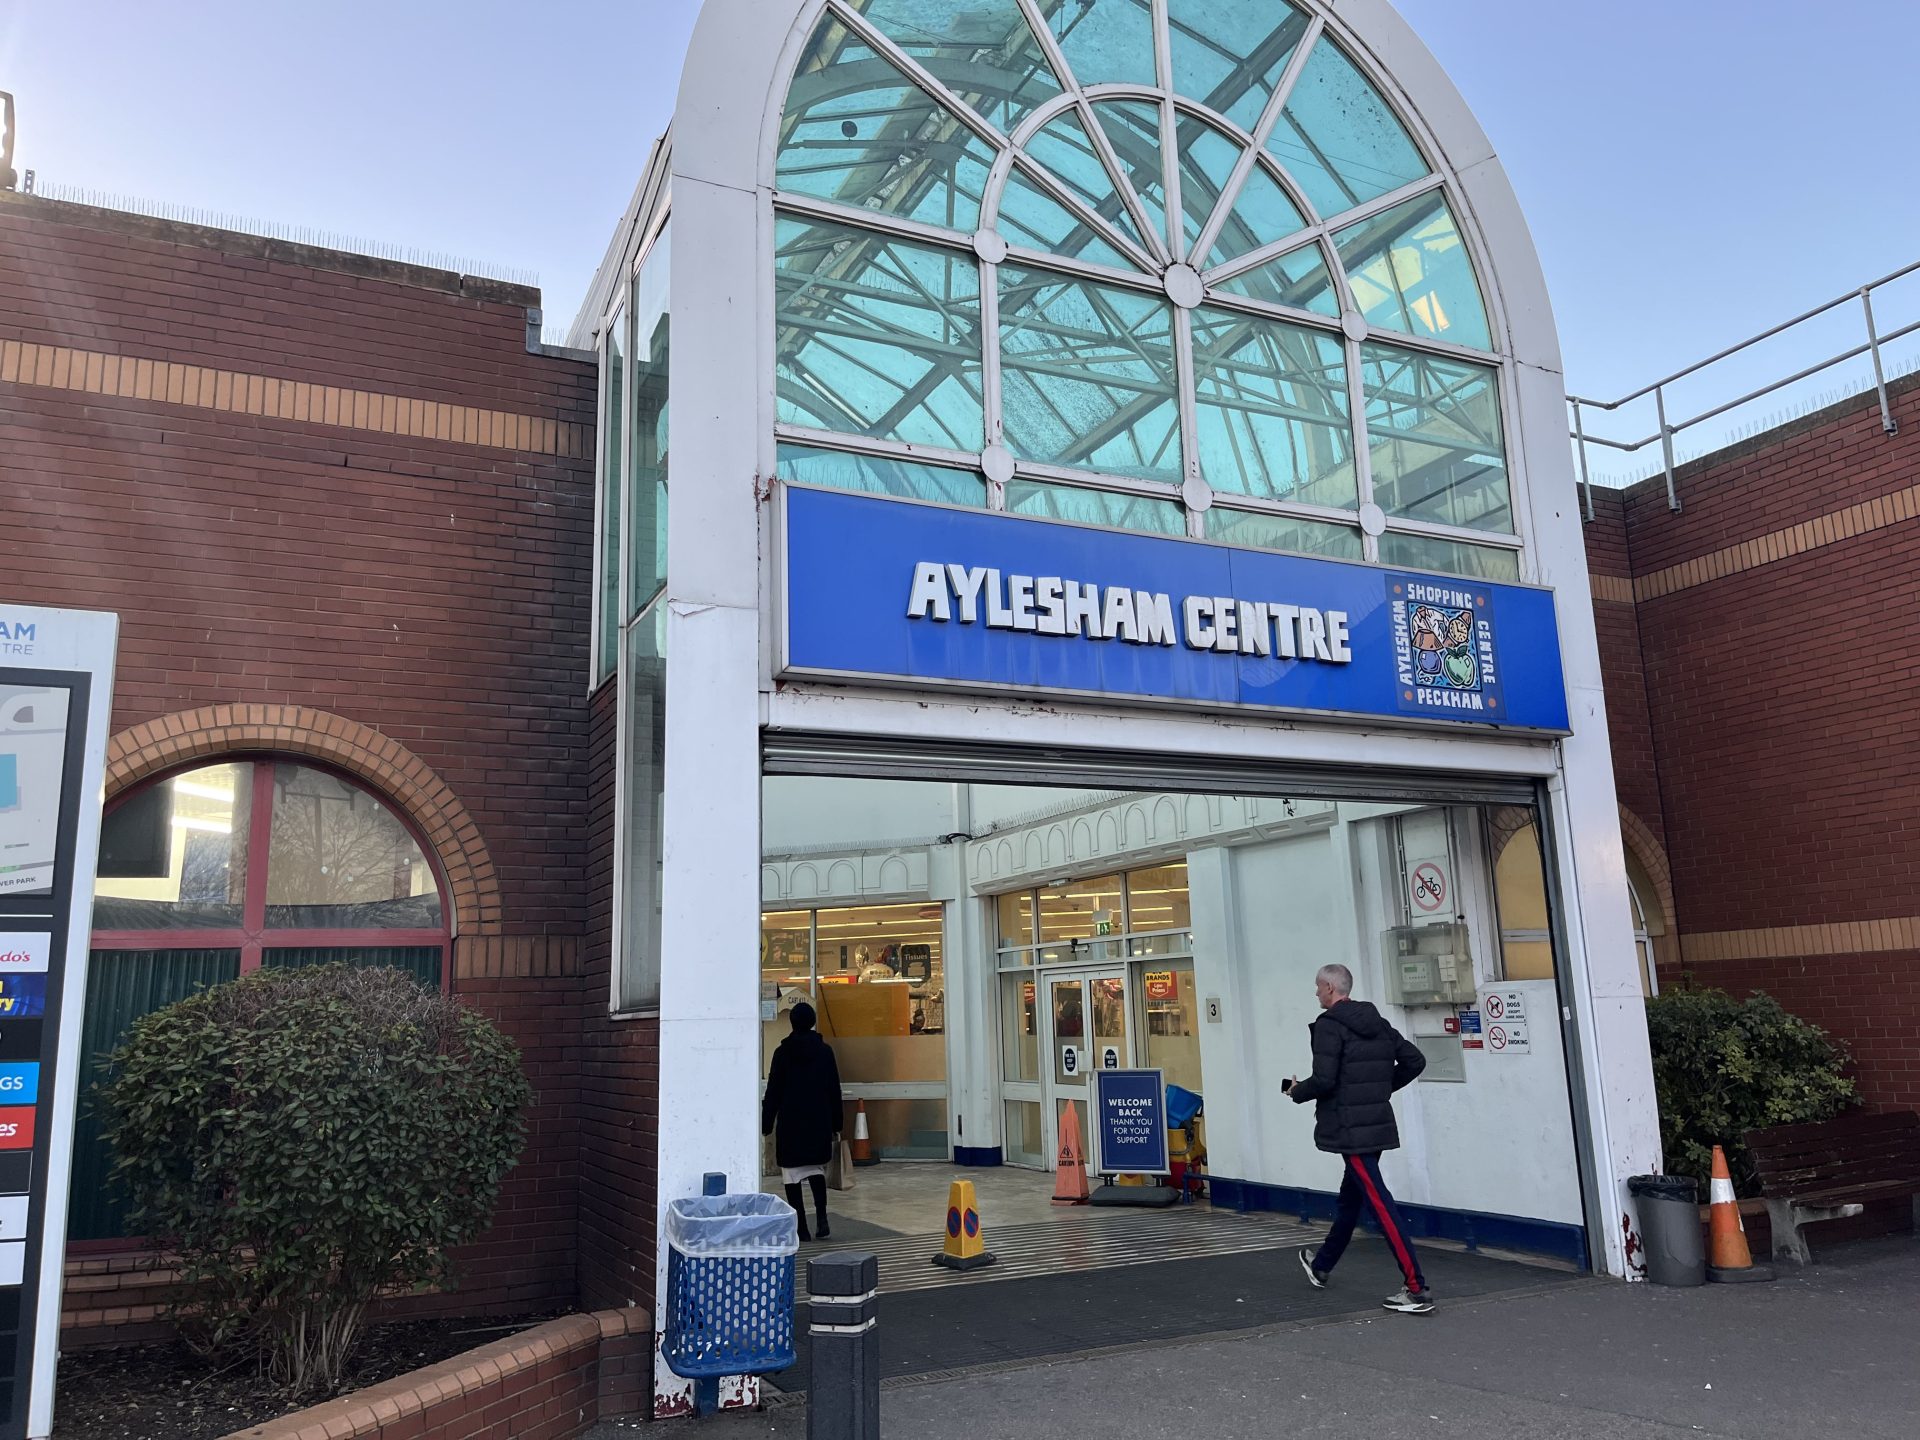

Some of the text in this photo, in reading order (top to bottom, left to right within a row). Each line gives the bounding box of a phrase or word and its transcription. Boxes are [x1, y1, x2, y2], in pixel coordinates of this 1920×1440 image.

[1407, 583, 1473, 609] SHOPPING
[907, 561, 1352, 664] AYLESHAM CENTRE
[1392, 600, 1413, 686] AYLESHAM
[1477, 620, 1496, 684] CENTRE
[1417, 688, 1484, 710] PECKHAM
[16, 876, 36, 885] PARK
[1210, 1003, 1217, 1016] 3
[1108, 1098, 1153, 1106] WELCOME
[1118, 1108, 1143, 1116] BACK
